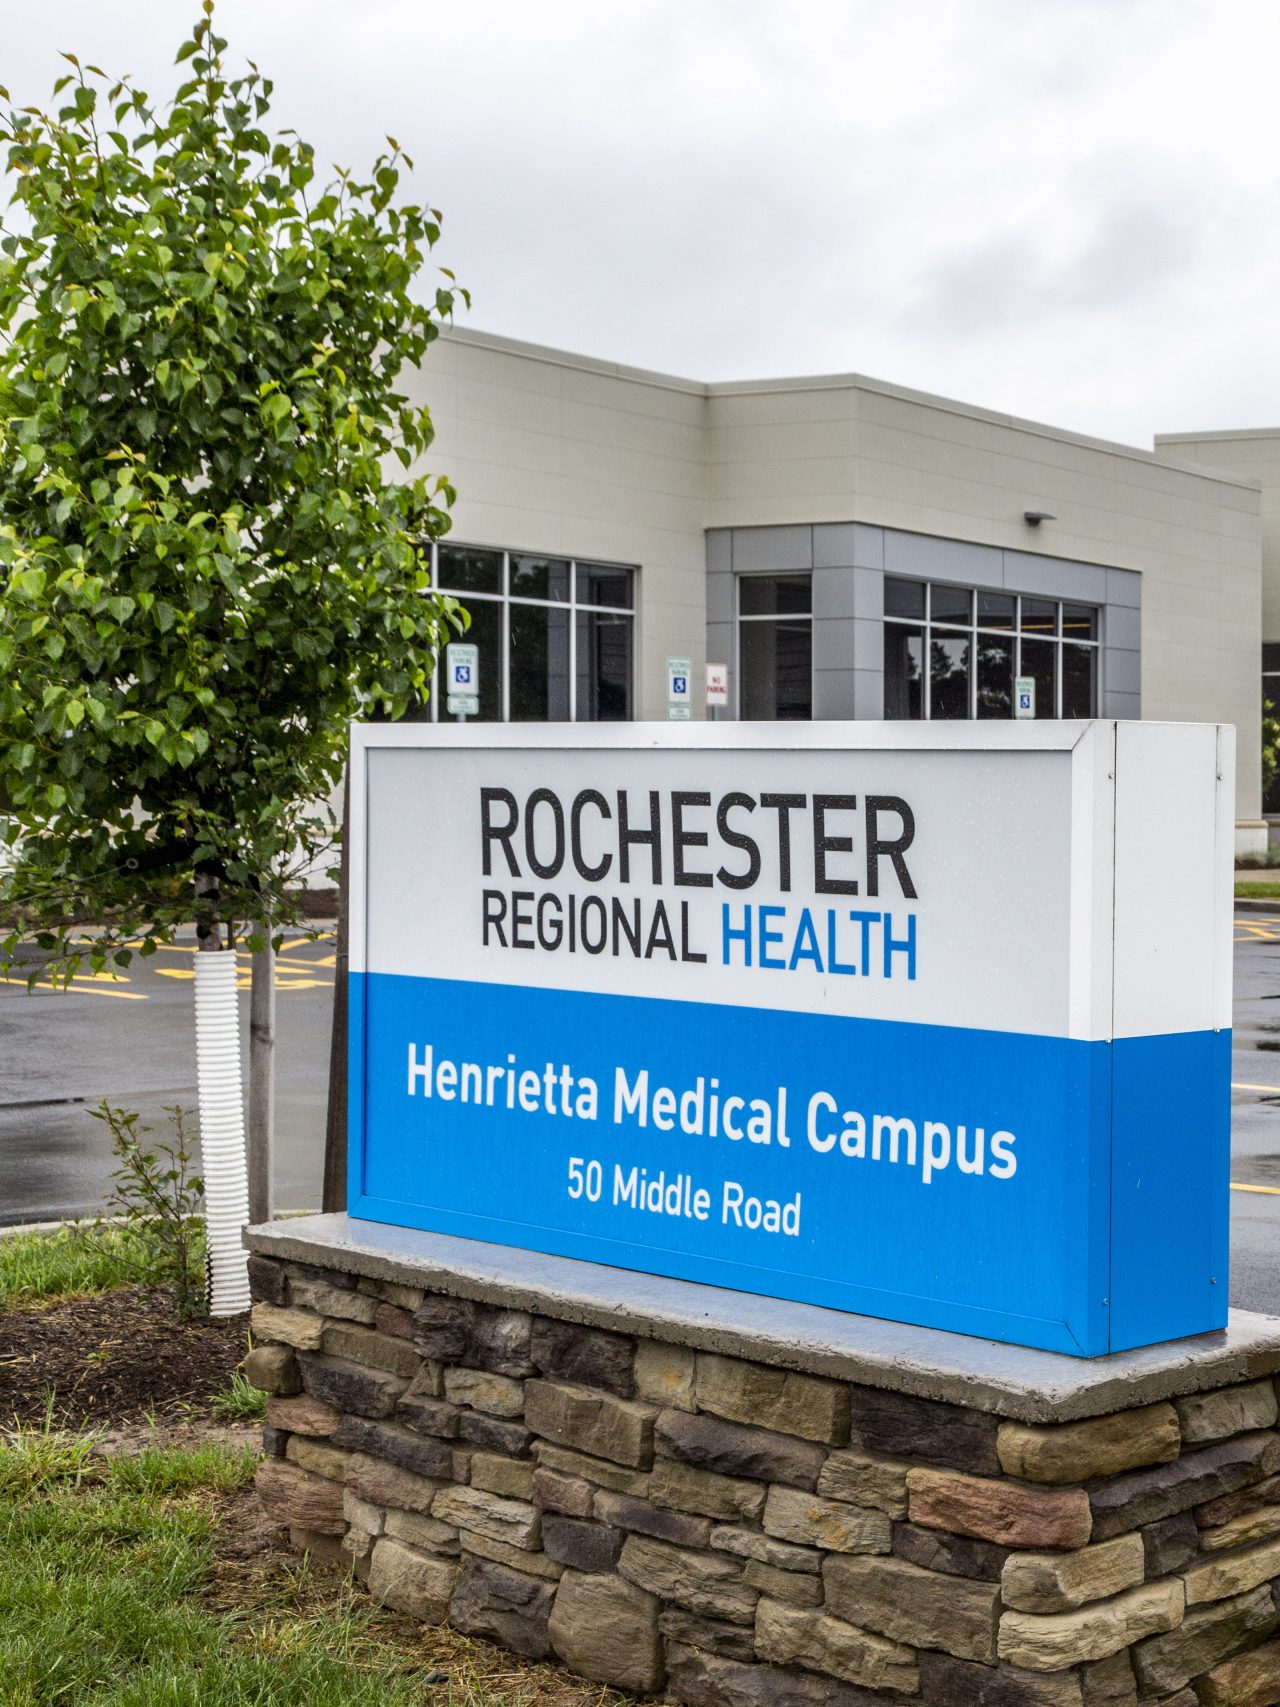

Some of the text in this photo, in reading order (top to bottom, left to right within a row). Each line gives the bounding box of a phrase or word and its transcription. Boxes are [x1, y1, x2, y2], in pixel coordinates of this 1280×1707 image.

[480, 787, 918, 900] ROCHESTER
[482, 889, 918, 982] REGIONAL HEALTH
[407, 1042, 1017, 1185] Henrietta Medical Campus
[567, 1157, 801, 1237] 50 Middle Road
